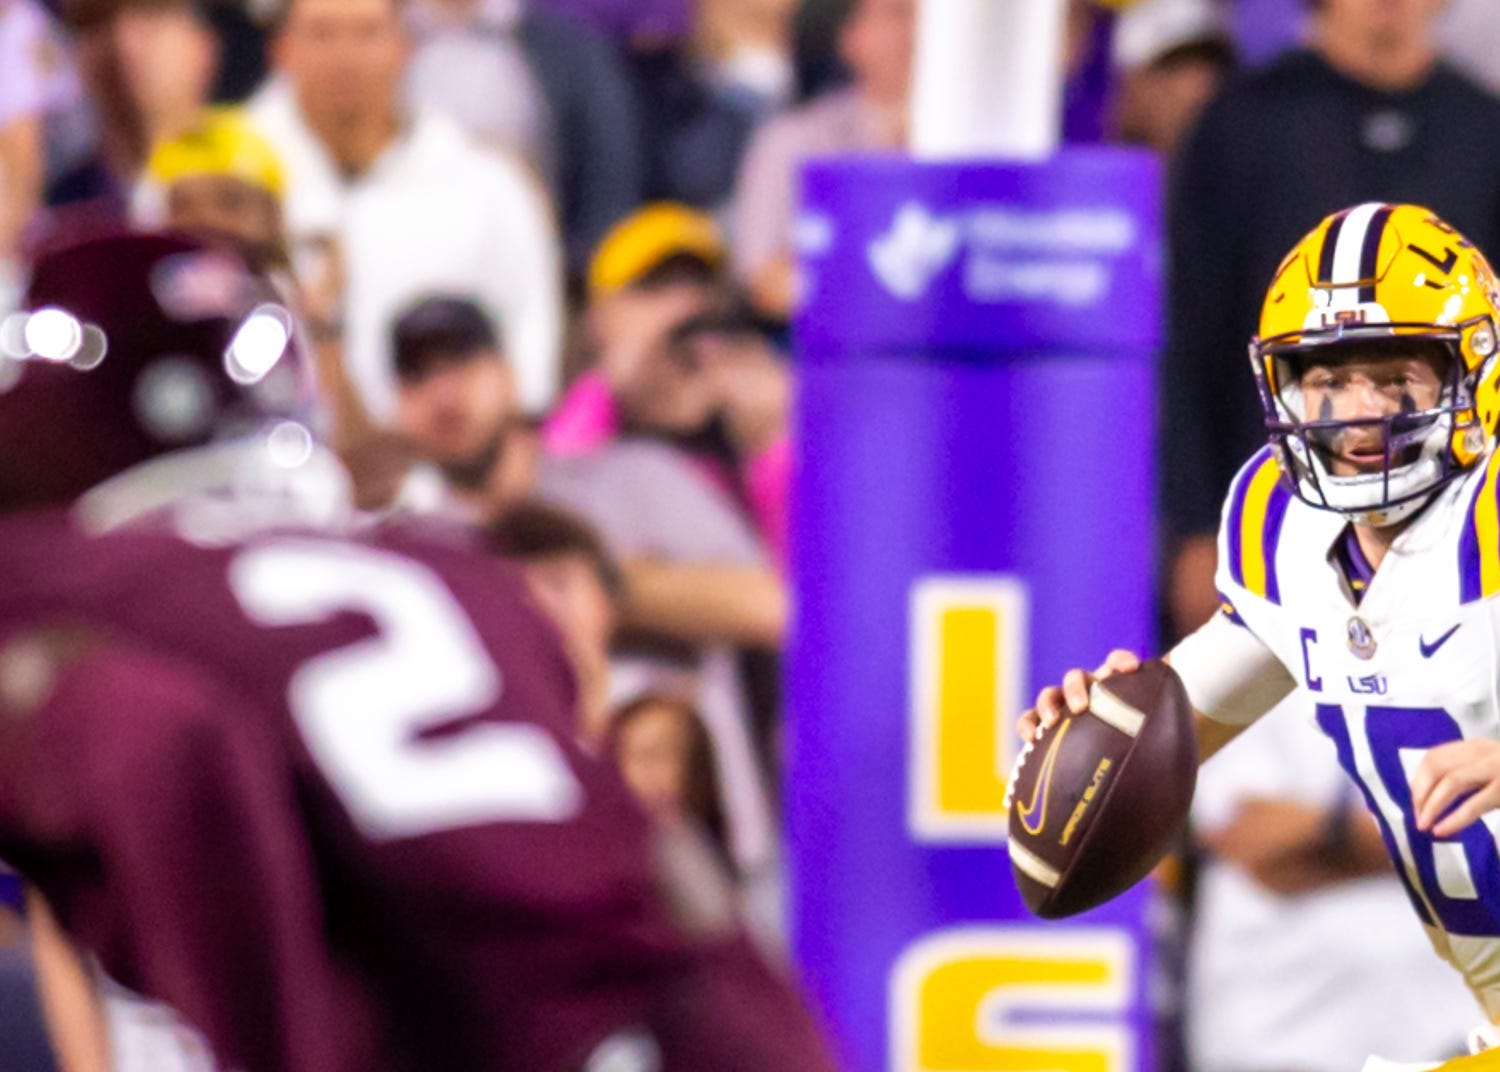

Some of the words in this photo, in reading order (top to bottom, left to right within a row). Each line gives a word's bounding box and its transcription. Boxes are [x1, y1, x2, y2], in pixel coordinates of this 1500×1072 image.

[226, 533, 585, 840] 2
[1300, 627, 1323, 691] C
[1347, 674, 1388, 695] LSU
